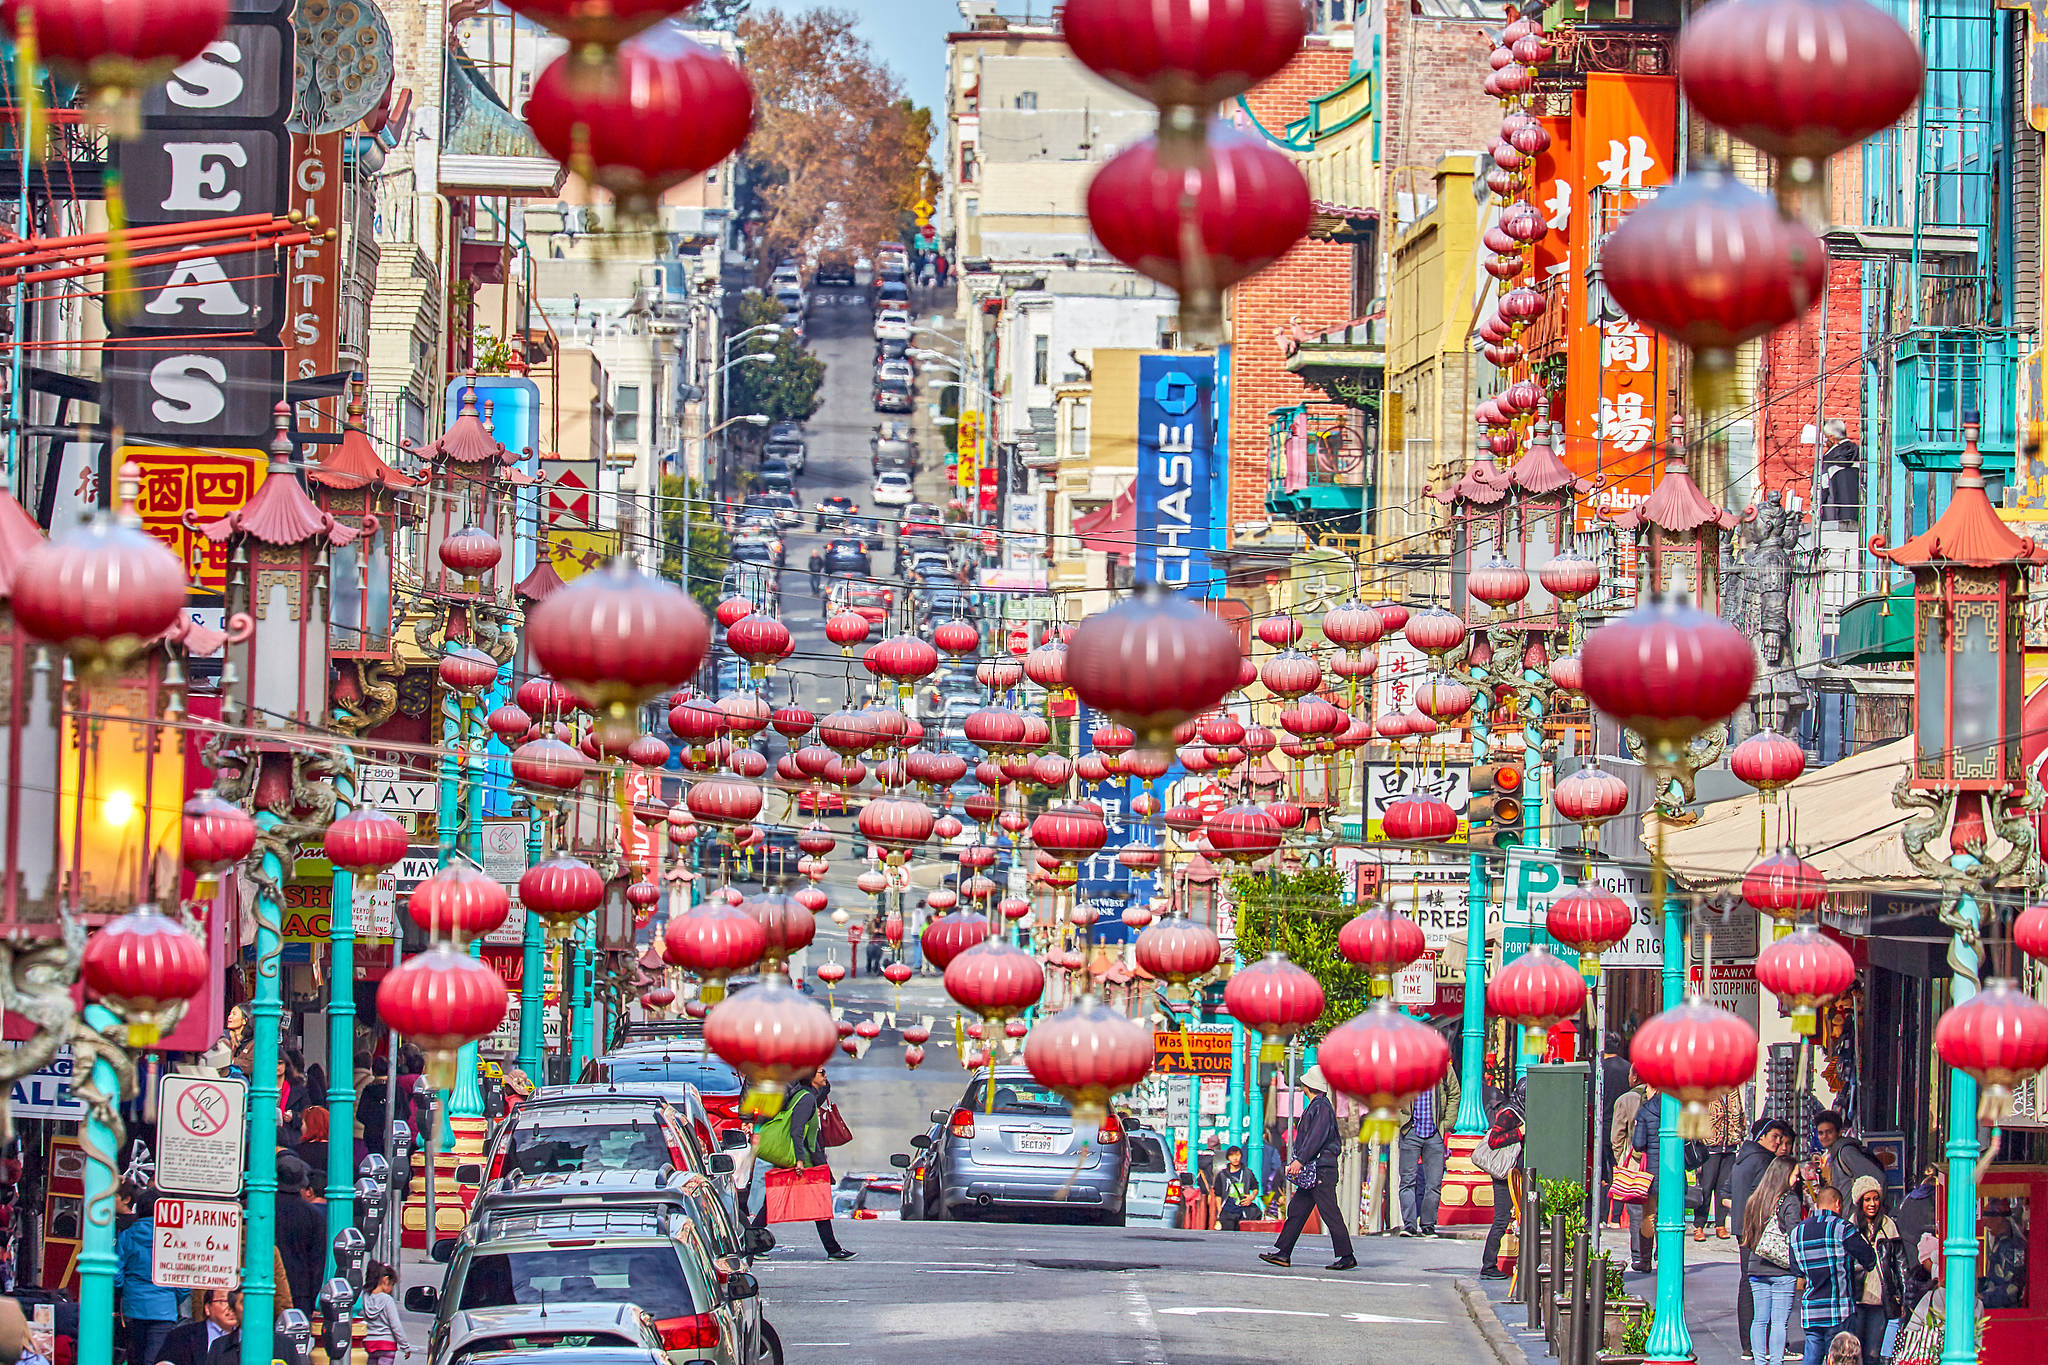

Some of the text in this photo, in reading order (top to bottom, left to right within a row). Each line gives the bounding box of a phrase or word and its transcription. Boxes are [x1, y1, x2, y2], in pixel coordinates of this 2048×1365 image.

[1592, 136, 1658, 452] 北商場
[1157, 423, 1193, 590] CHASE
[1391, 655, 1409, 702] 北京
[374, 769, 394, 779] 800
[360, 785, 424, 805] LAY
[403, 861, 439, 878] WAY
[1599, 878, 1635, 893] IGHT
[1400, 909, 1468, 929] MPRES
[359, 925, 388, 933] CLENING
[1505, 942, 1560, 955] PORTTH
[1637, 939, 1664, 953] RIG
[1403, 963, 1433, 973] TOPPING
[1697, 968, 1753, 978] TW-AWAY
[1403, 975, 1421, 984] ANY
[1402, 985, 1421, 995] TIME
[1712, 981, 1757, 995] STOPPING
[1714, 1000, 1738, 1013] ANY
[9, 1080, 81, 1107] ALE
[1021, 1140, 1051, 1150] 5ECT399
[158, 1202, 237, 1228] NO PARKING
[177, 1252, 214, 1262] EVERYDAY
[160, 1262, 233, 1274] INCLUDING HOLIDAYS
[162, 1273, 229, 1286] STREET CLEANING
